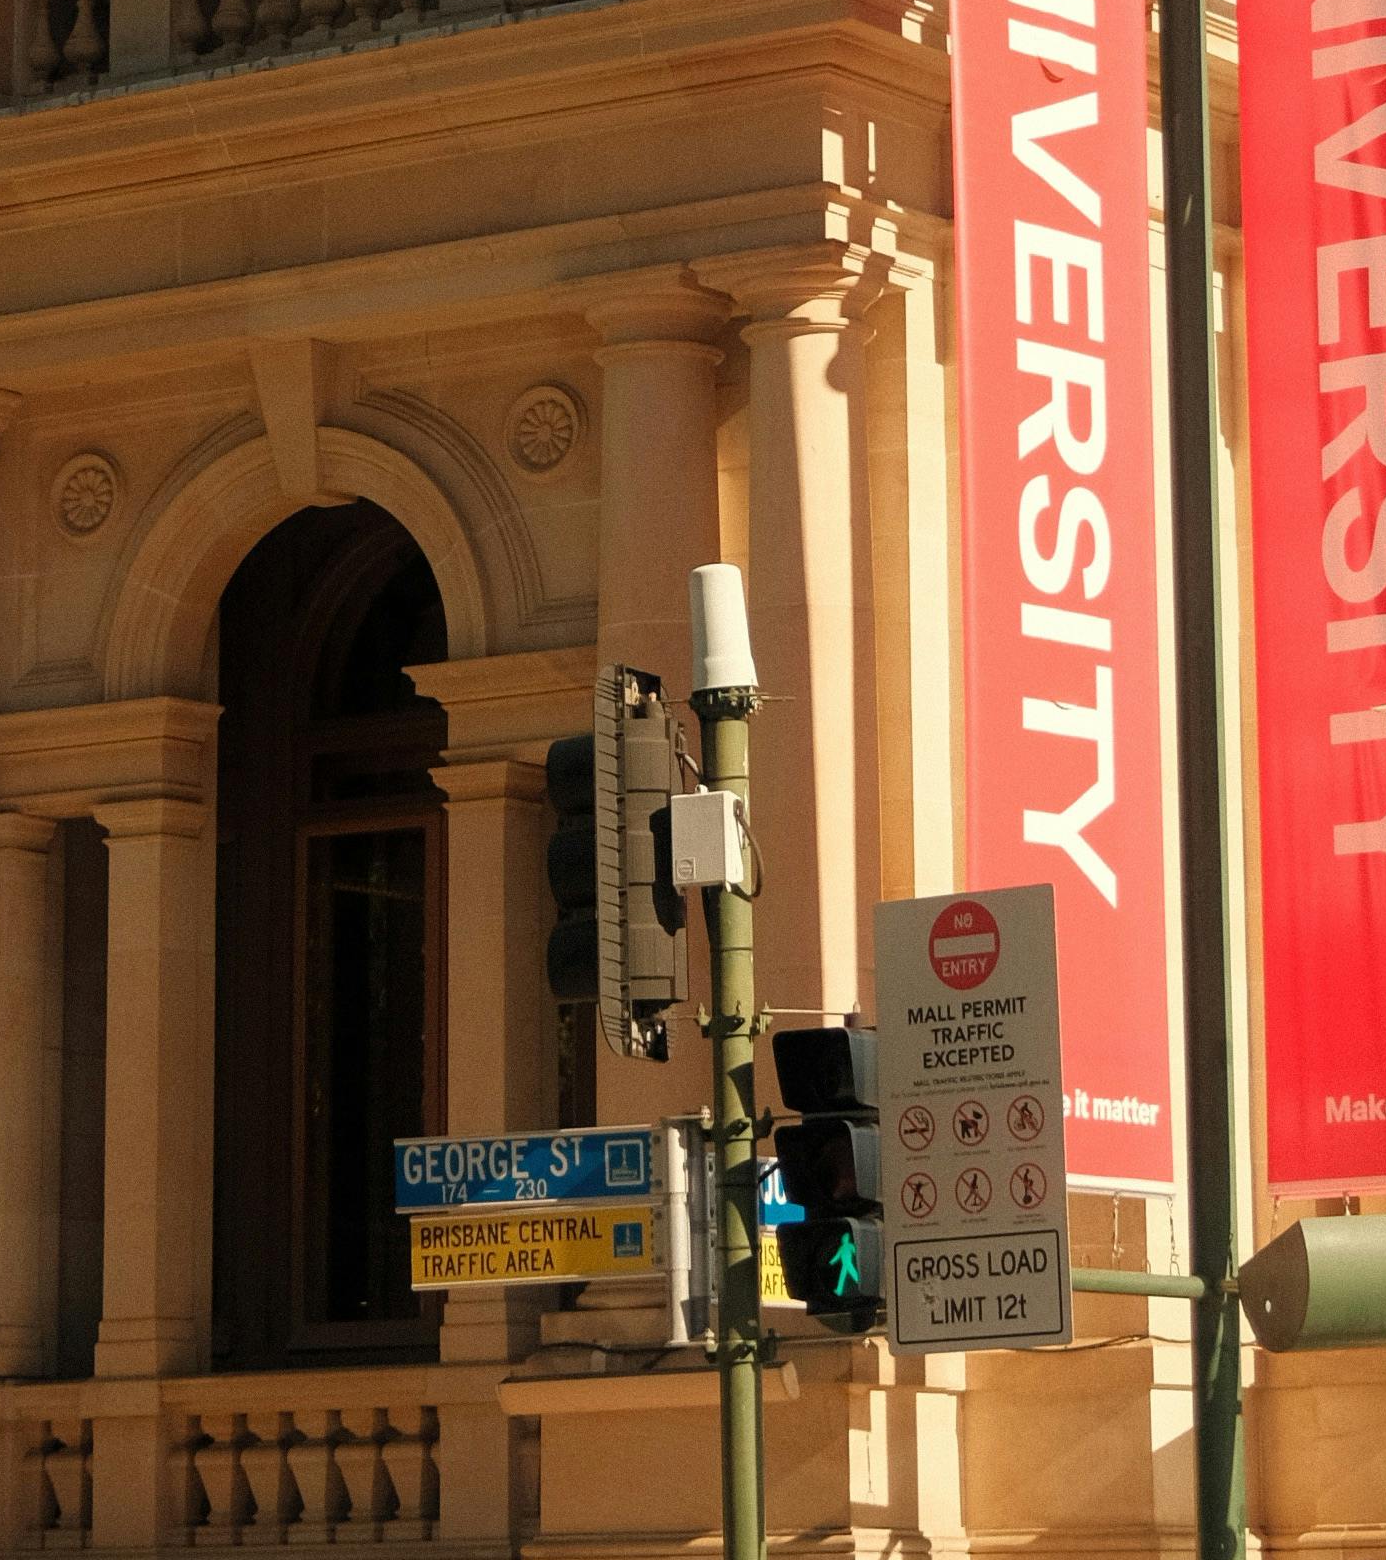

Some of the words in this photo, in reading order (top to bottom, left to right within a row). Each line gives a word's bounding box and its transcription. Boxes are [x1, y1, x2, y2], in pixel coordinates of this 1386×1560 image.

[953, 912, 973, 929] NO
[941, 957, 988, 978] ENTRY
[907, 1004, 956, 1025] MALL
[961, 996, 1027, 1019] PERMIT
[930, 1022, 1004, 1046] TRAFFIC
[922, 1044, 1015, 1069] EXCEPTED
[1074, 1090, 1090, 1119] it
[1093, 1094, 1160, 1127] matter
[403, 1140, 529, 1185] GEORGE
[549, 1136, 584, 1178] ST
[441, 1183, 468, 1204] 174
[514, 1179, 547, 1200] 230
[420, 1222, 510, 1249] BRISBANE
[518, 1216, 603, 1244] CENTRAL
[421, 1253, 497, 1278] TRAFFIC
[505, 1248, 554, 1272] AREA
[907, 1253, 980, 1283] GROSS
[987, 1248, 1048, 1277] LOAD
[931, 1296, 986, 1325] LIMIT
[997, 1293, 1027, 1320] 12t
